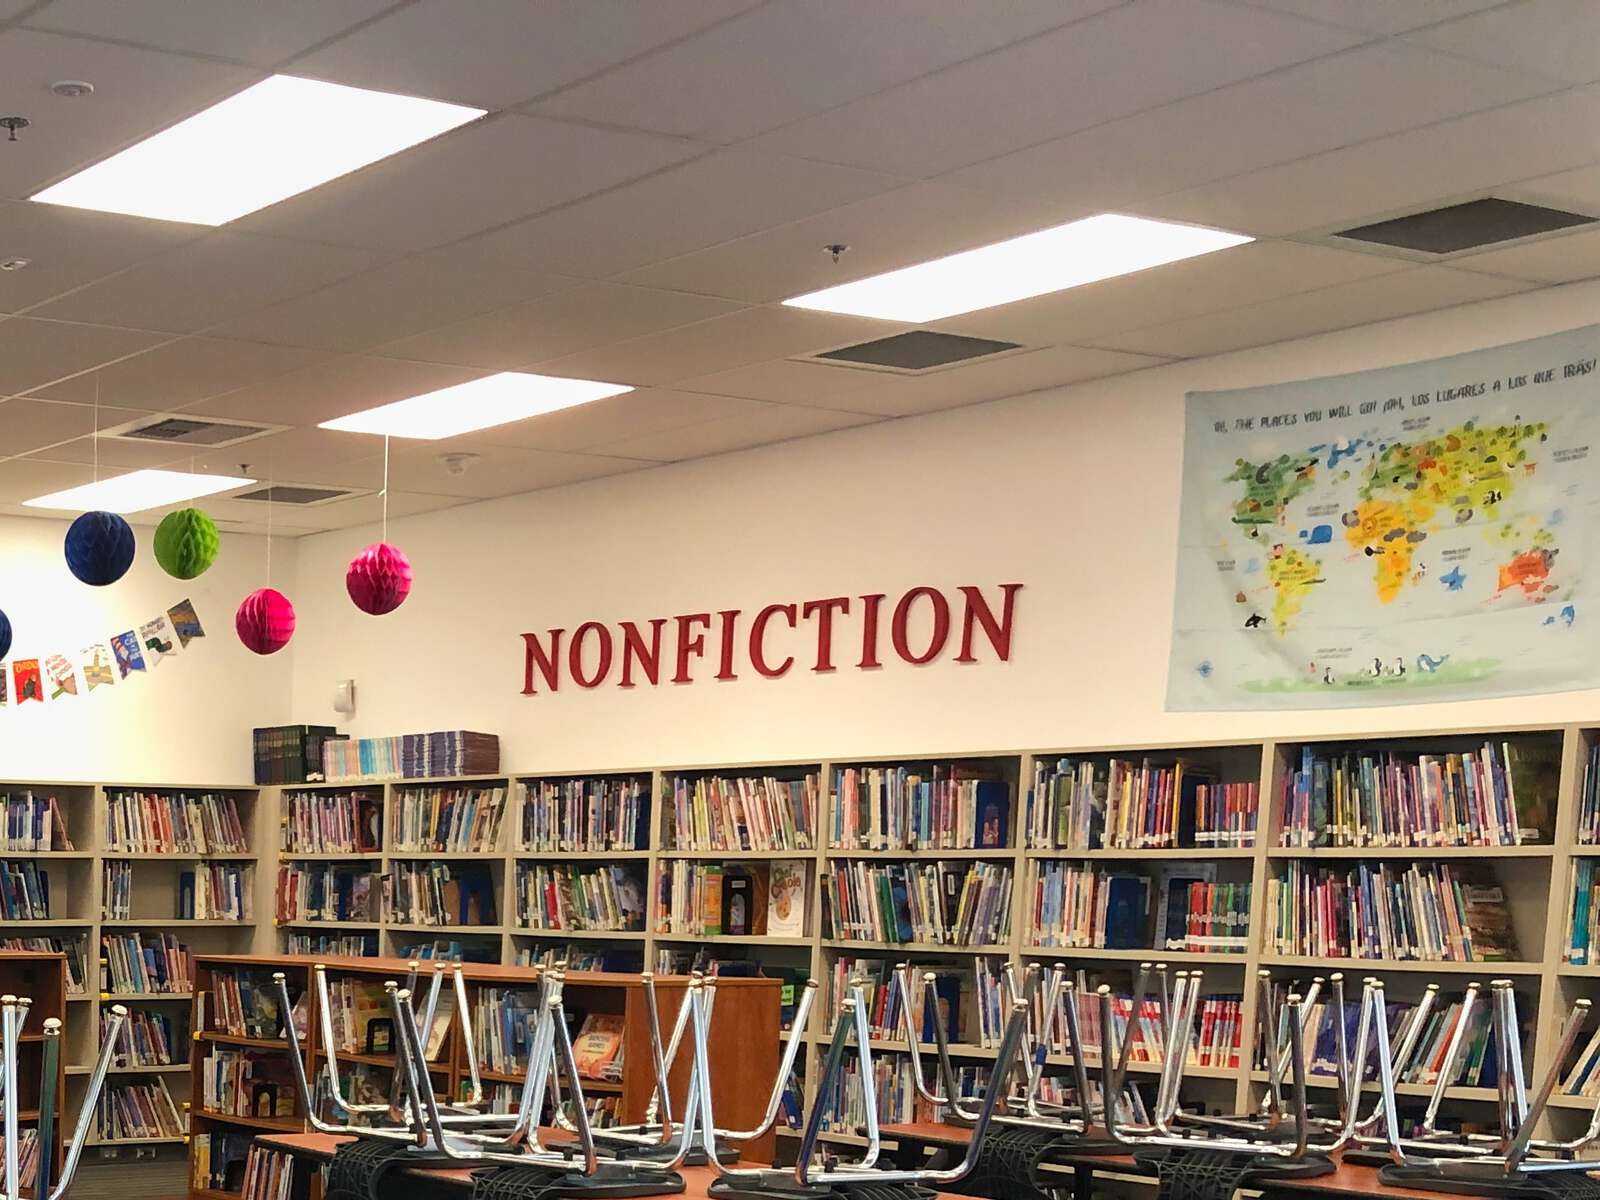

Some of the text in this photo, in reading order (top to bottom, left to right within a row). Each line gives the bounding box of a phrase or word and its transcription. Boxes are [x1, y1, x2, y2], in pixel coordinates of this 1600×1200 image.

[1235, 417, 1254, 431] THE
[1260, 413, 1298, 429] PLACES
[1304, 410, 1322, 424] YOU
[1328, 404, 1352, 419] WILL
[1412, 392, 1430, 407] LOS
[1436, 382, 1486, 403] LUGARES
[1492, 380, 1501, 392] A
[1508, 375, 1527, 390] LOS
[519, 583, 1024, 695] NONFICTION
